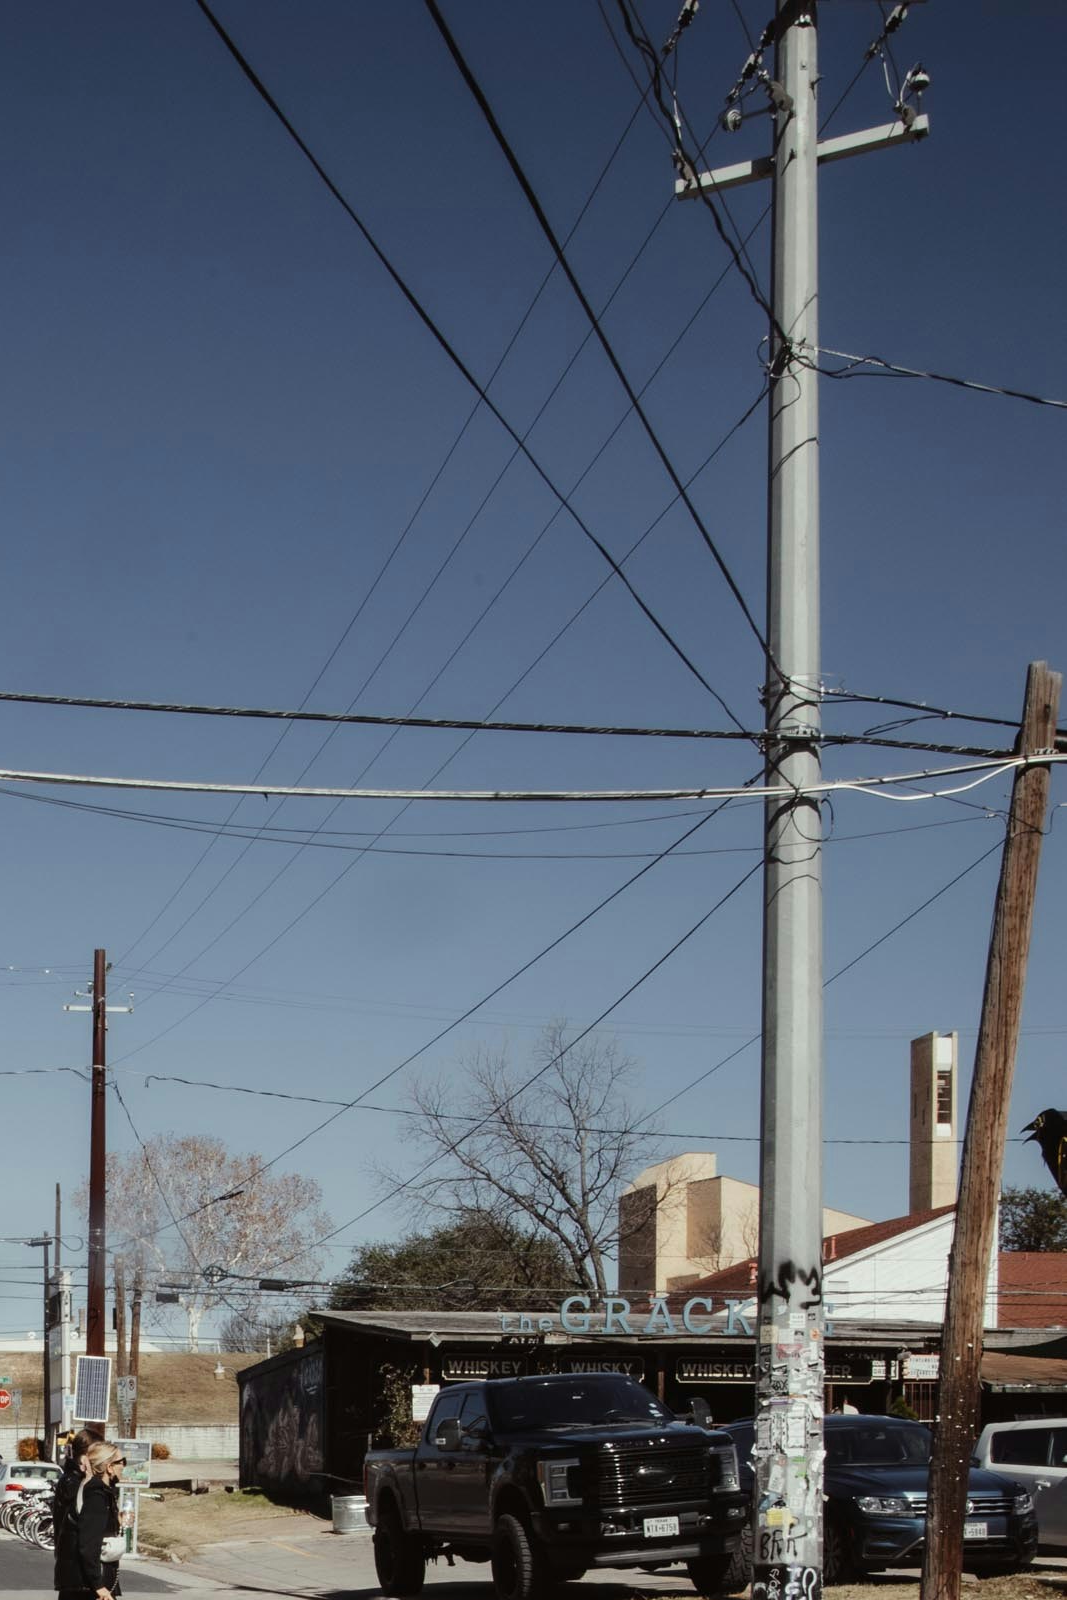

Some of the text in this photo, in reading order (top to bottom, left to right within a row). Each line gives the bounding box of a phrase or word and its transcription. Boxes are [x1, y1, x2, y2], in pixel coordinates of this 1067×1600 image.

[500, 1314, 554, 1333] the
[560, 1295, 834, 1336] GRACK
[448, 1360, 522, 1375] WHISKEY
[570, 1361, 633, 1374] WHISKY
[682, 1362, 755, 1378] WHISKEY
